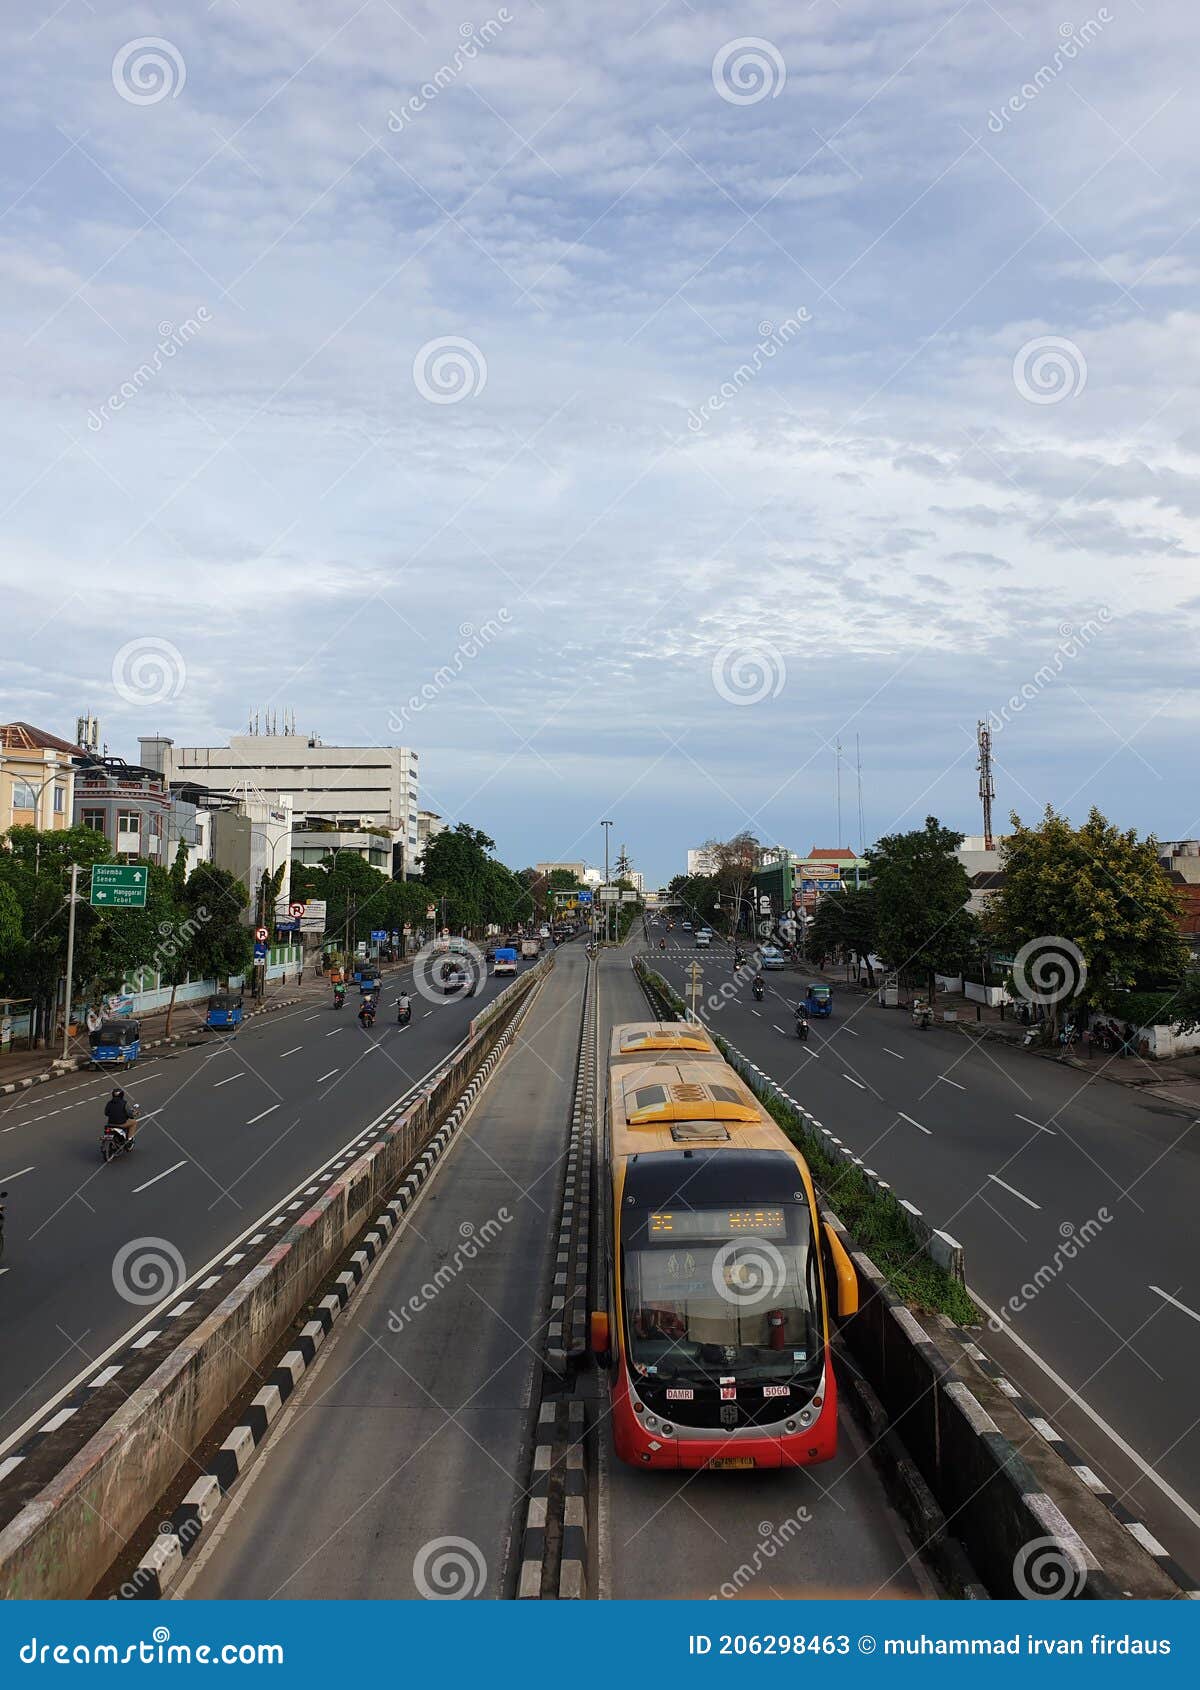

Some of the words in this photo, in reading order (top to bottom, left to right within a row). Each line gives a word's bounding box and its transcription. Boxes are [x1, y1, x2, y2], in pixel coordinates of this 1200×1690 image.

[113, 889, 142, 897] Manggarai
[667, 1389, 693, 1399] DAMRI
[765, 1386, 788, 1396] 5060
